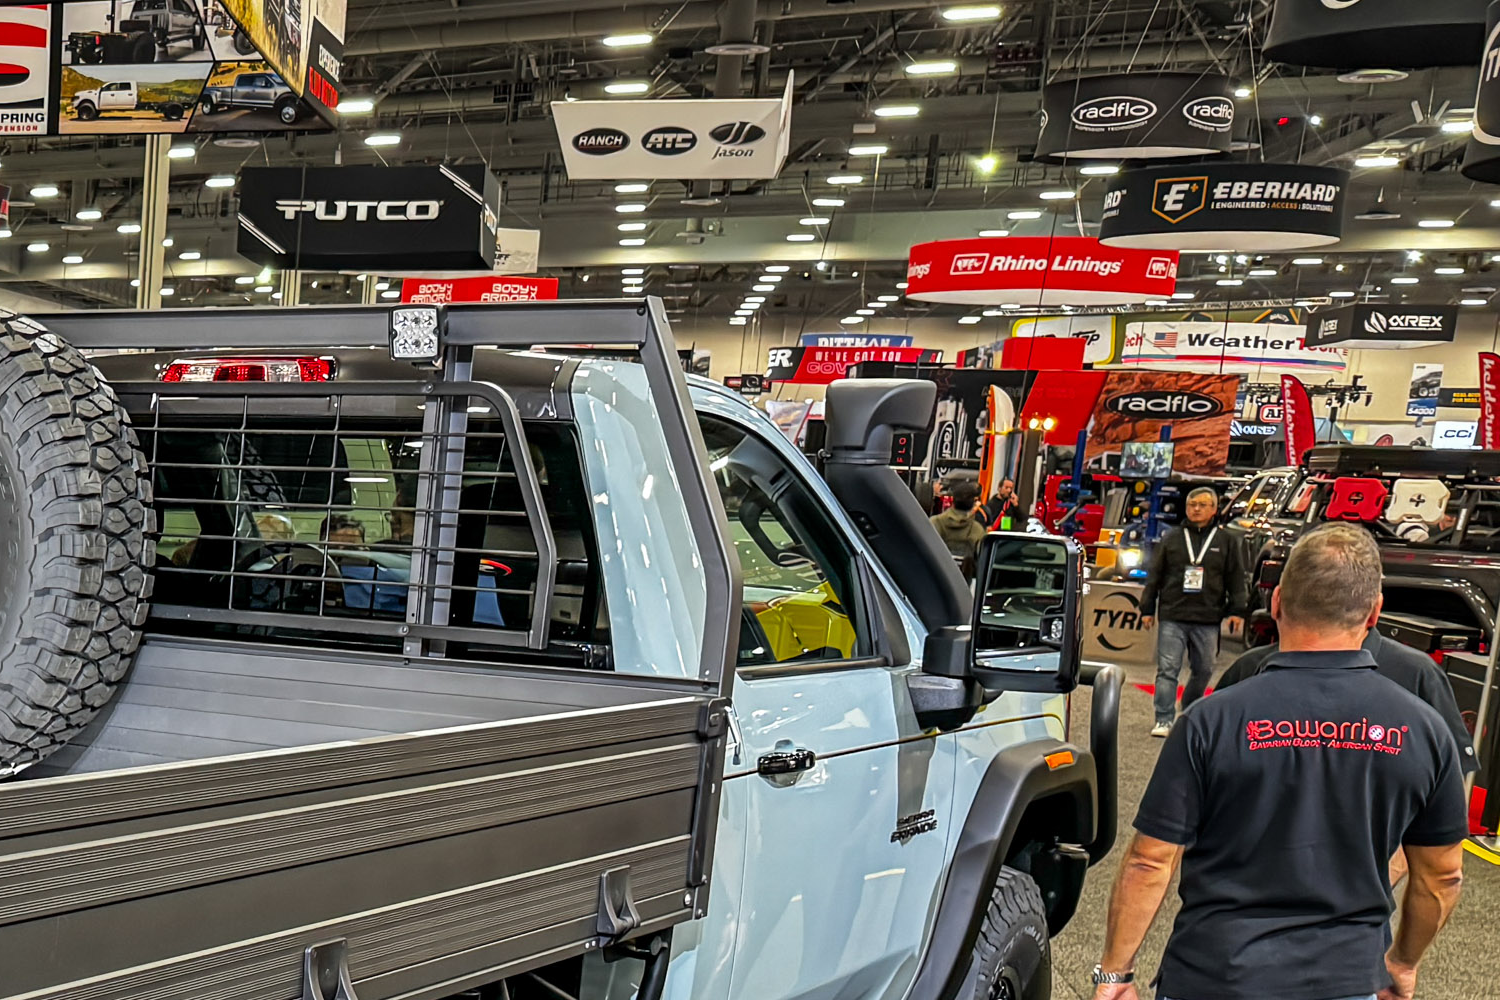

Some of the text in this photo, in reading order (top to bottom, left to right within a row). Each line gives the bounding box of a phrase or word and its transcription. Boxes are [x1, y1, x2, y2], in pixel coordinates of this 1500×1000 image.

[1079, 103, 1149, 119] radflo
[1192, 103, 1233, 120] radflo
[578, 134, 624, 147] RANCH
[646, 133, 693, 149] ATC
[276, 200, 444, 222] PUTCO
[989, 255, 1122, 276] Rhino Linings
[419, 284, 446, 293] BODY
[492, 283, 529, 293] BODY
[410, 293, 446, 303] ARMOR
[854, 351, 875, 362] GOT
[882, 351, 902, 362] YOU
[1117, 396, 1213, 413] radflo
